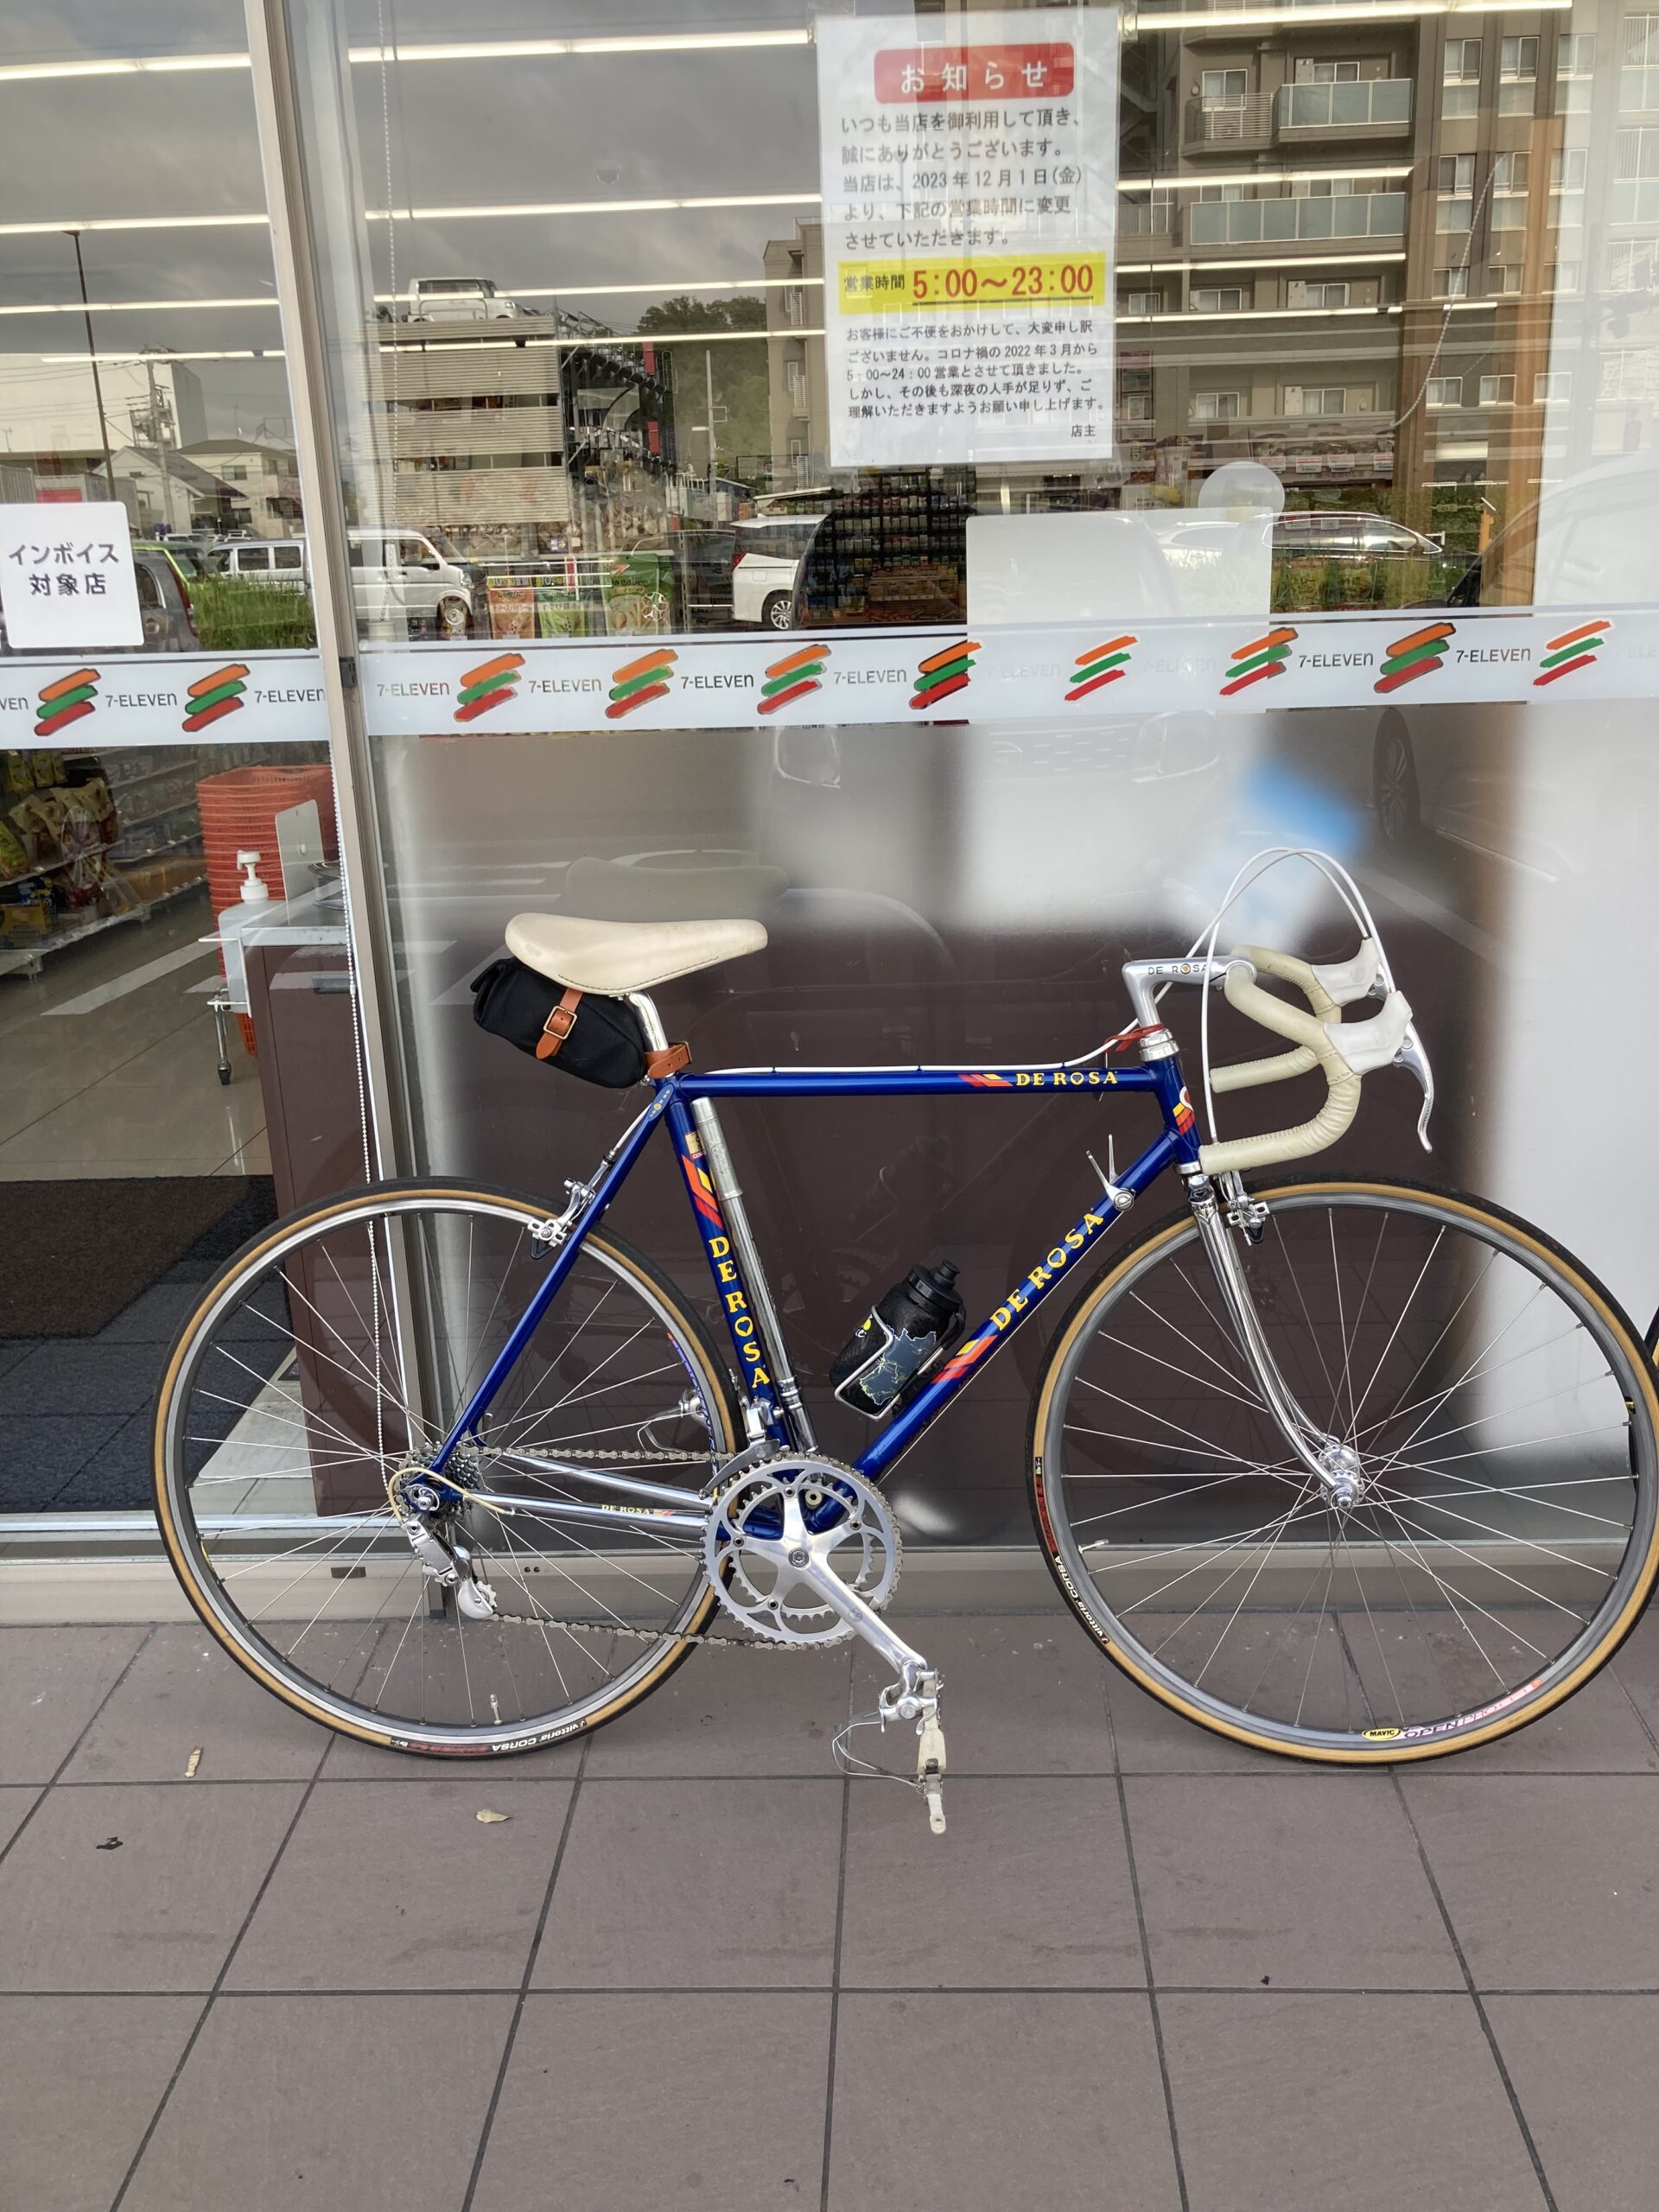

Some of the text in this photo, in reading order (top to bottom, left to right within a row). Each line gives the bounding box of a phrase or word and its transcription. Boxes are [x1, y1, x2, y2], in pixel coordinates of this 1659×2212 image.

[900, 62, 1048, 94] お知らせ
[841, 107, 1080, 133] いつも当店を御利用して頂き、
[841, 138, 1062, 164] 誠にありがとうございます。
[843, 195, 1071, 221] より、下記の営業時間に変更
[845, 229, 1009, 251] させていただきます。
[843, 274, 906, 292] 営業時間
[846, 320, 1093, 341] お客様にご不便をおかけして、大変申し訳
[849, 378, 1091, 400] しかし、その後も深夜の人手が足りず、ご
[1071, 424, 1096, 438] 店主
[8, 542, 119, 566] インボイス
[29, 572, 106, 596] 対象店
[1147, 963, 1208, 976] DE ROSA
[1015, 1071, 1118, 1086] DE ROSA
[989, 1211, 1103, 1332] DE ROSA
[708, 1236, 771, 1389] DE ROSA
[620, 1506, 651, 1515] ROSA
[1054, 1555, 1078, 1599] CORSA
[1369, 1728, 1395, 1738] MAVIC
[492, 1737, 537, 1752] CORSA
